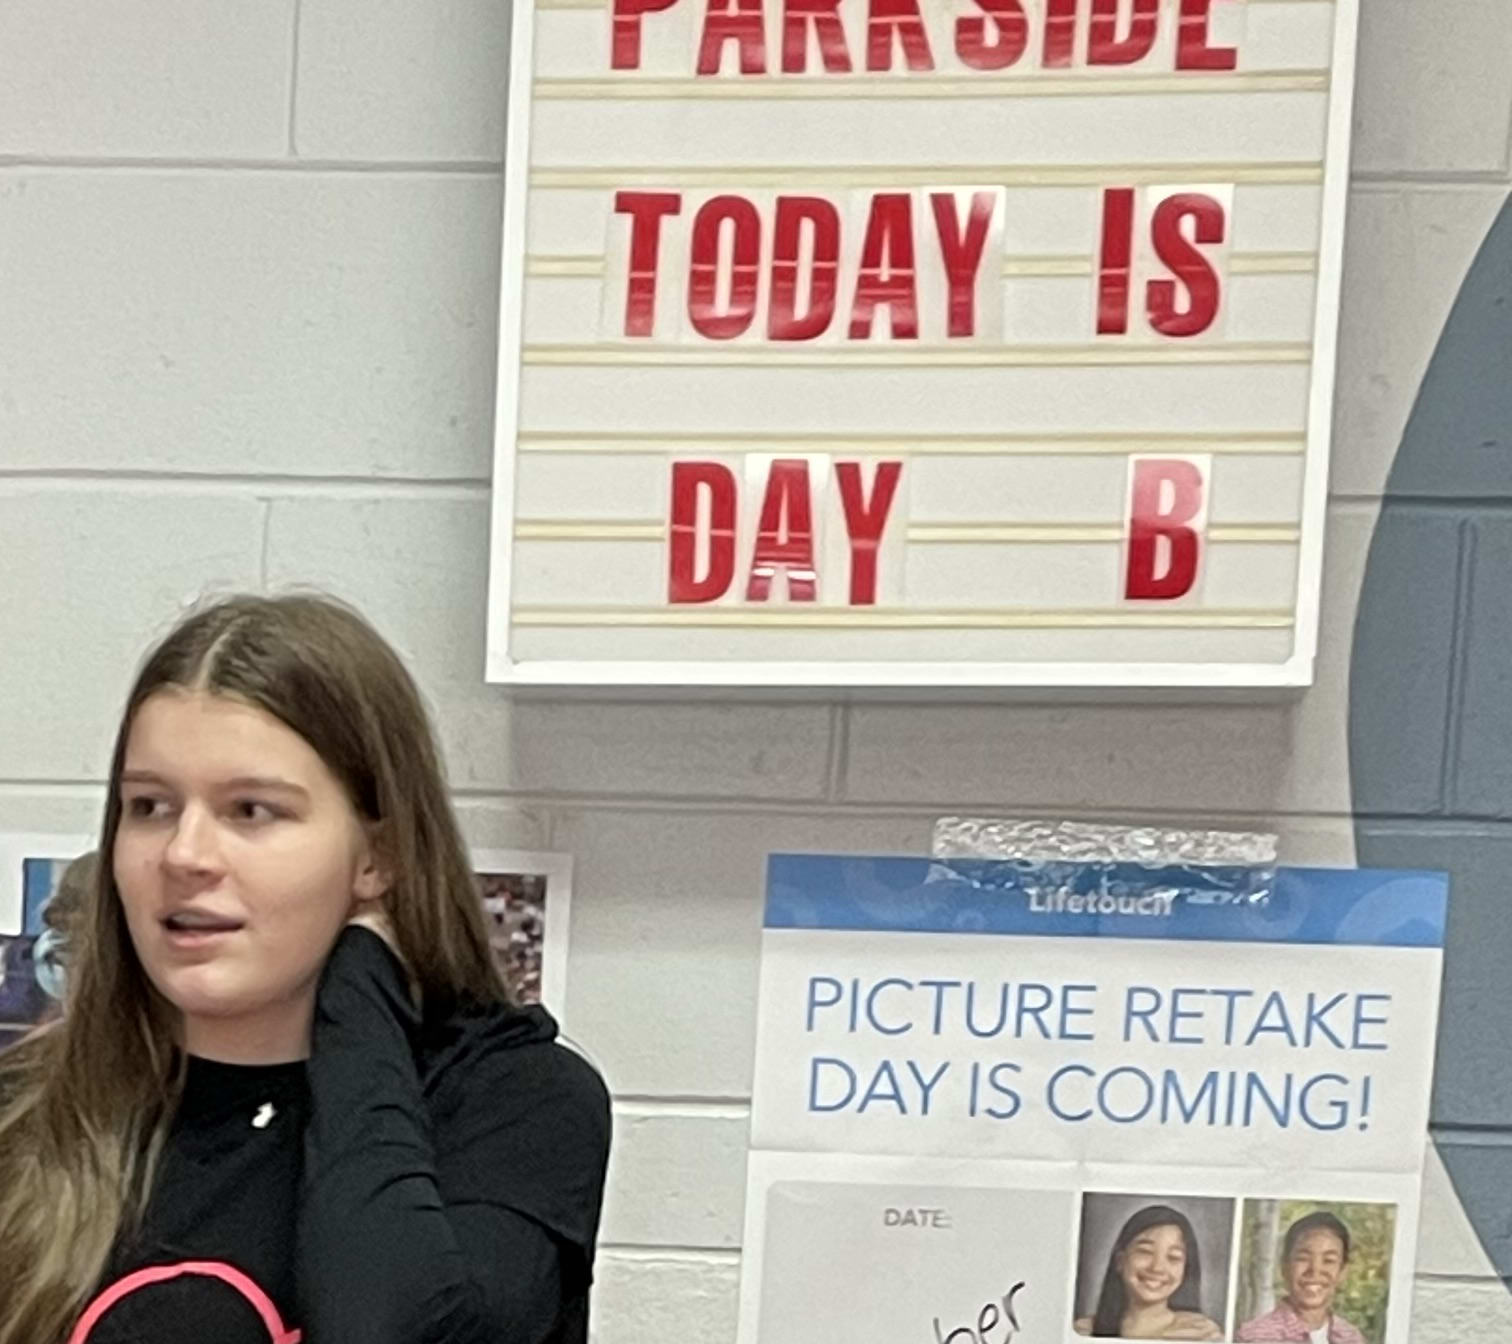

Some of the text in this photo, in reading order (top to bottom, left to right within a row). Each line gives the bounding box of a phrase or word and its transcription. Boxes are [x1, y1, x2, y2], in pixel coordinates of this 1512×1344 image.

[614, 187, 1226, 342] TODAY IS
[667, 458, 1204, 606] DAY B
[805, 976, 1393, 1051] PICTURE RETAKE
[807, 1057, 1371, 1132] DAY IS COMING!
